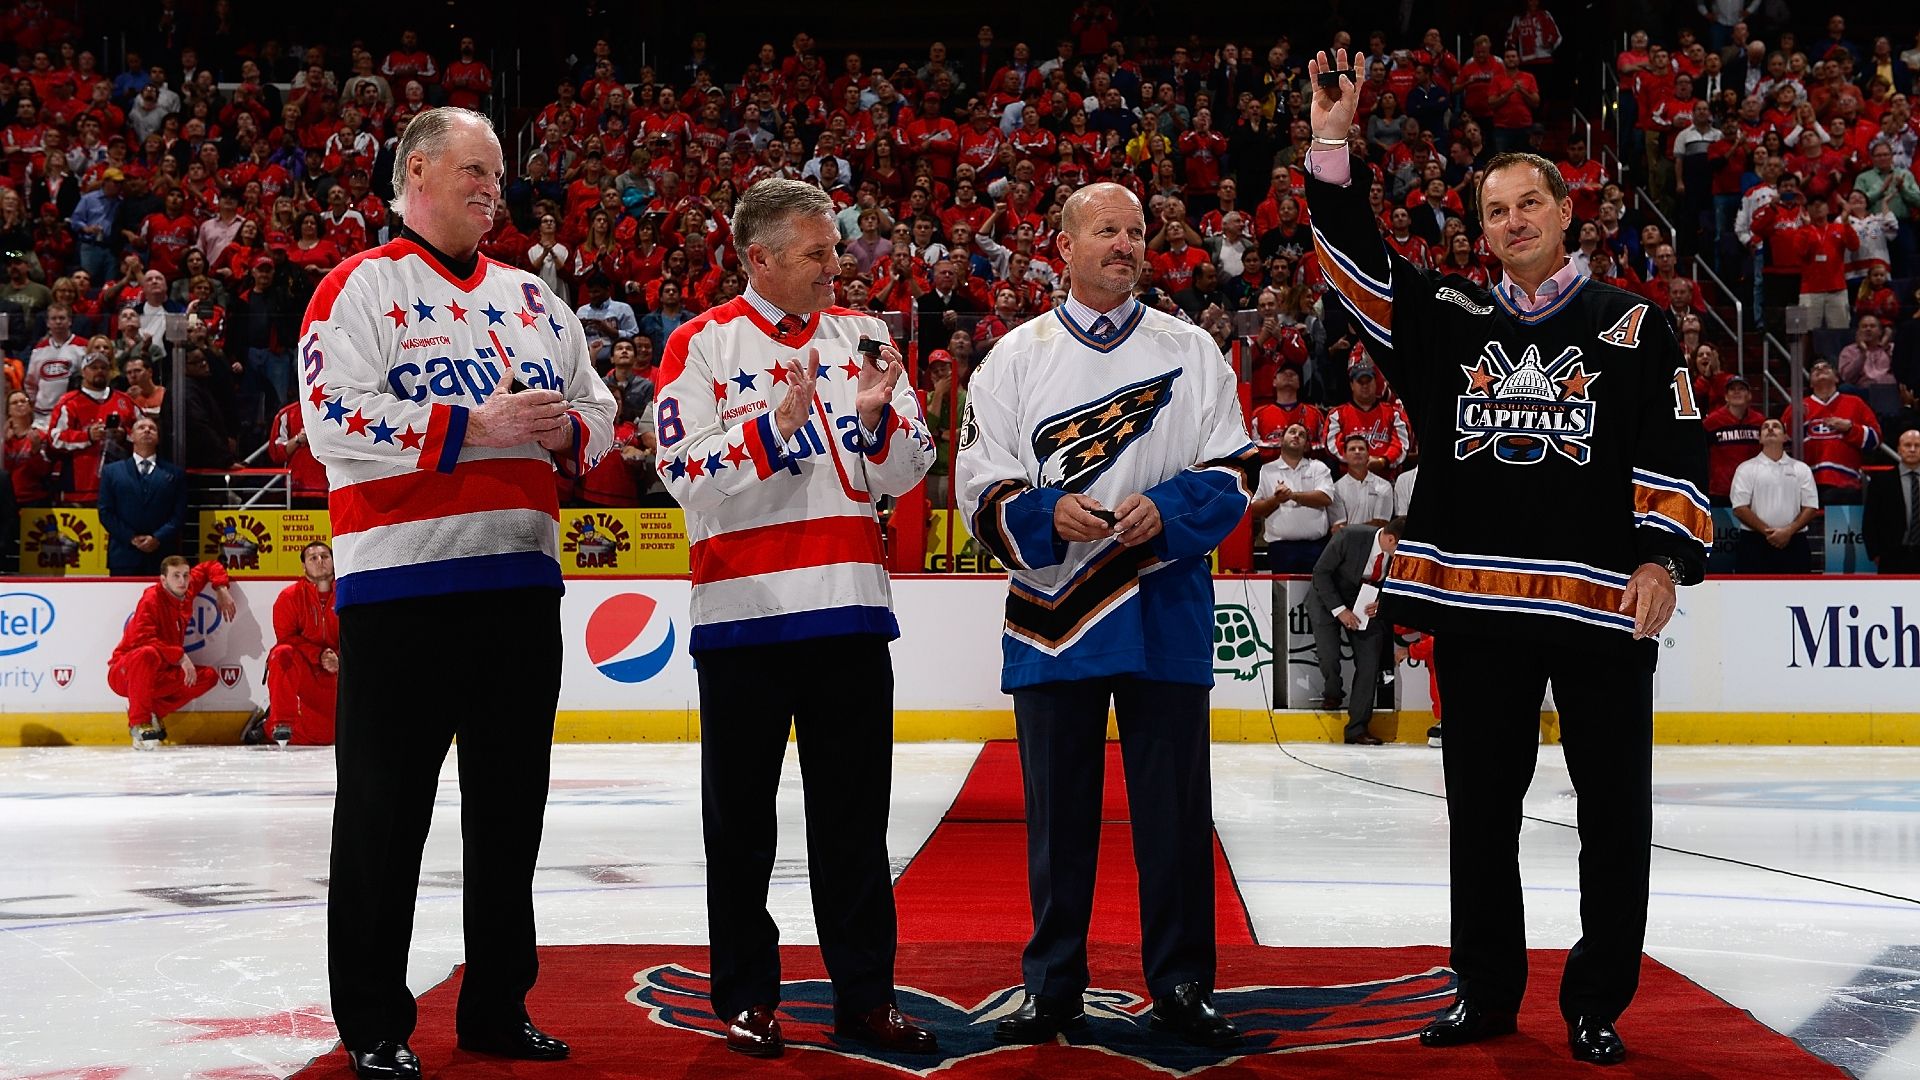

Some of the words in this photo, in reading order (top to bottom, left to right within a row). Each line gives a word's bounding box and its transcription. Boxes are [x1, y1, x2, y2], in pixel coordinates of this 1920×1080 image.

[520, 282, 546, 314] C
[1598, 303, 1649, 349] A
[400, 335, 451, 351] WASHINGTON
[302, 332, 324, 386] 5
[1463, 404, 1588, 432] CAPITALS
[1483, 402, 1567, 412] WASHINGTON
[658, 396, 686, 449] 8
[640, 512, 668, 520] CHILI
[640, 522, 673, 530] WINGS
[60, 513, 94, 552] TIMES
[239, 515, 274, 553] TIMES
[282, 524, 315, 532] WINGS
[282, 534, 328, 542] BURGERS
[597, 513, 631, 552] TIMES
[640, 532, 685, 540] BURGERS
[640, 542, 676, 550] SPORTS
[576, 552, 618, 568] CAFE
[1786, 605, 1920, 669] Mich
